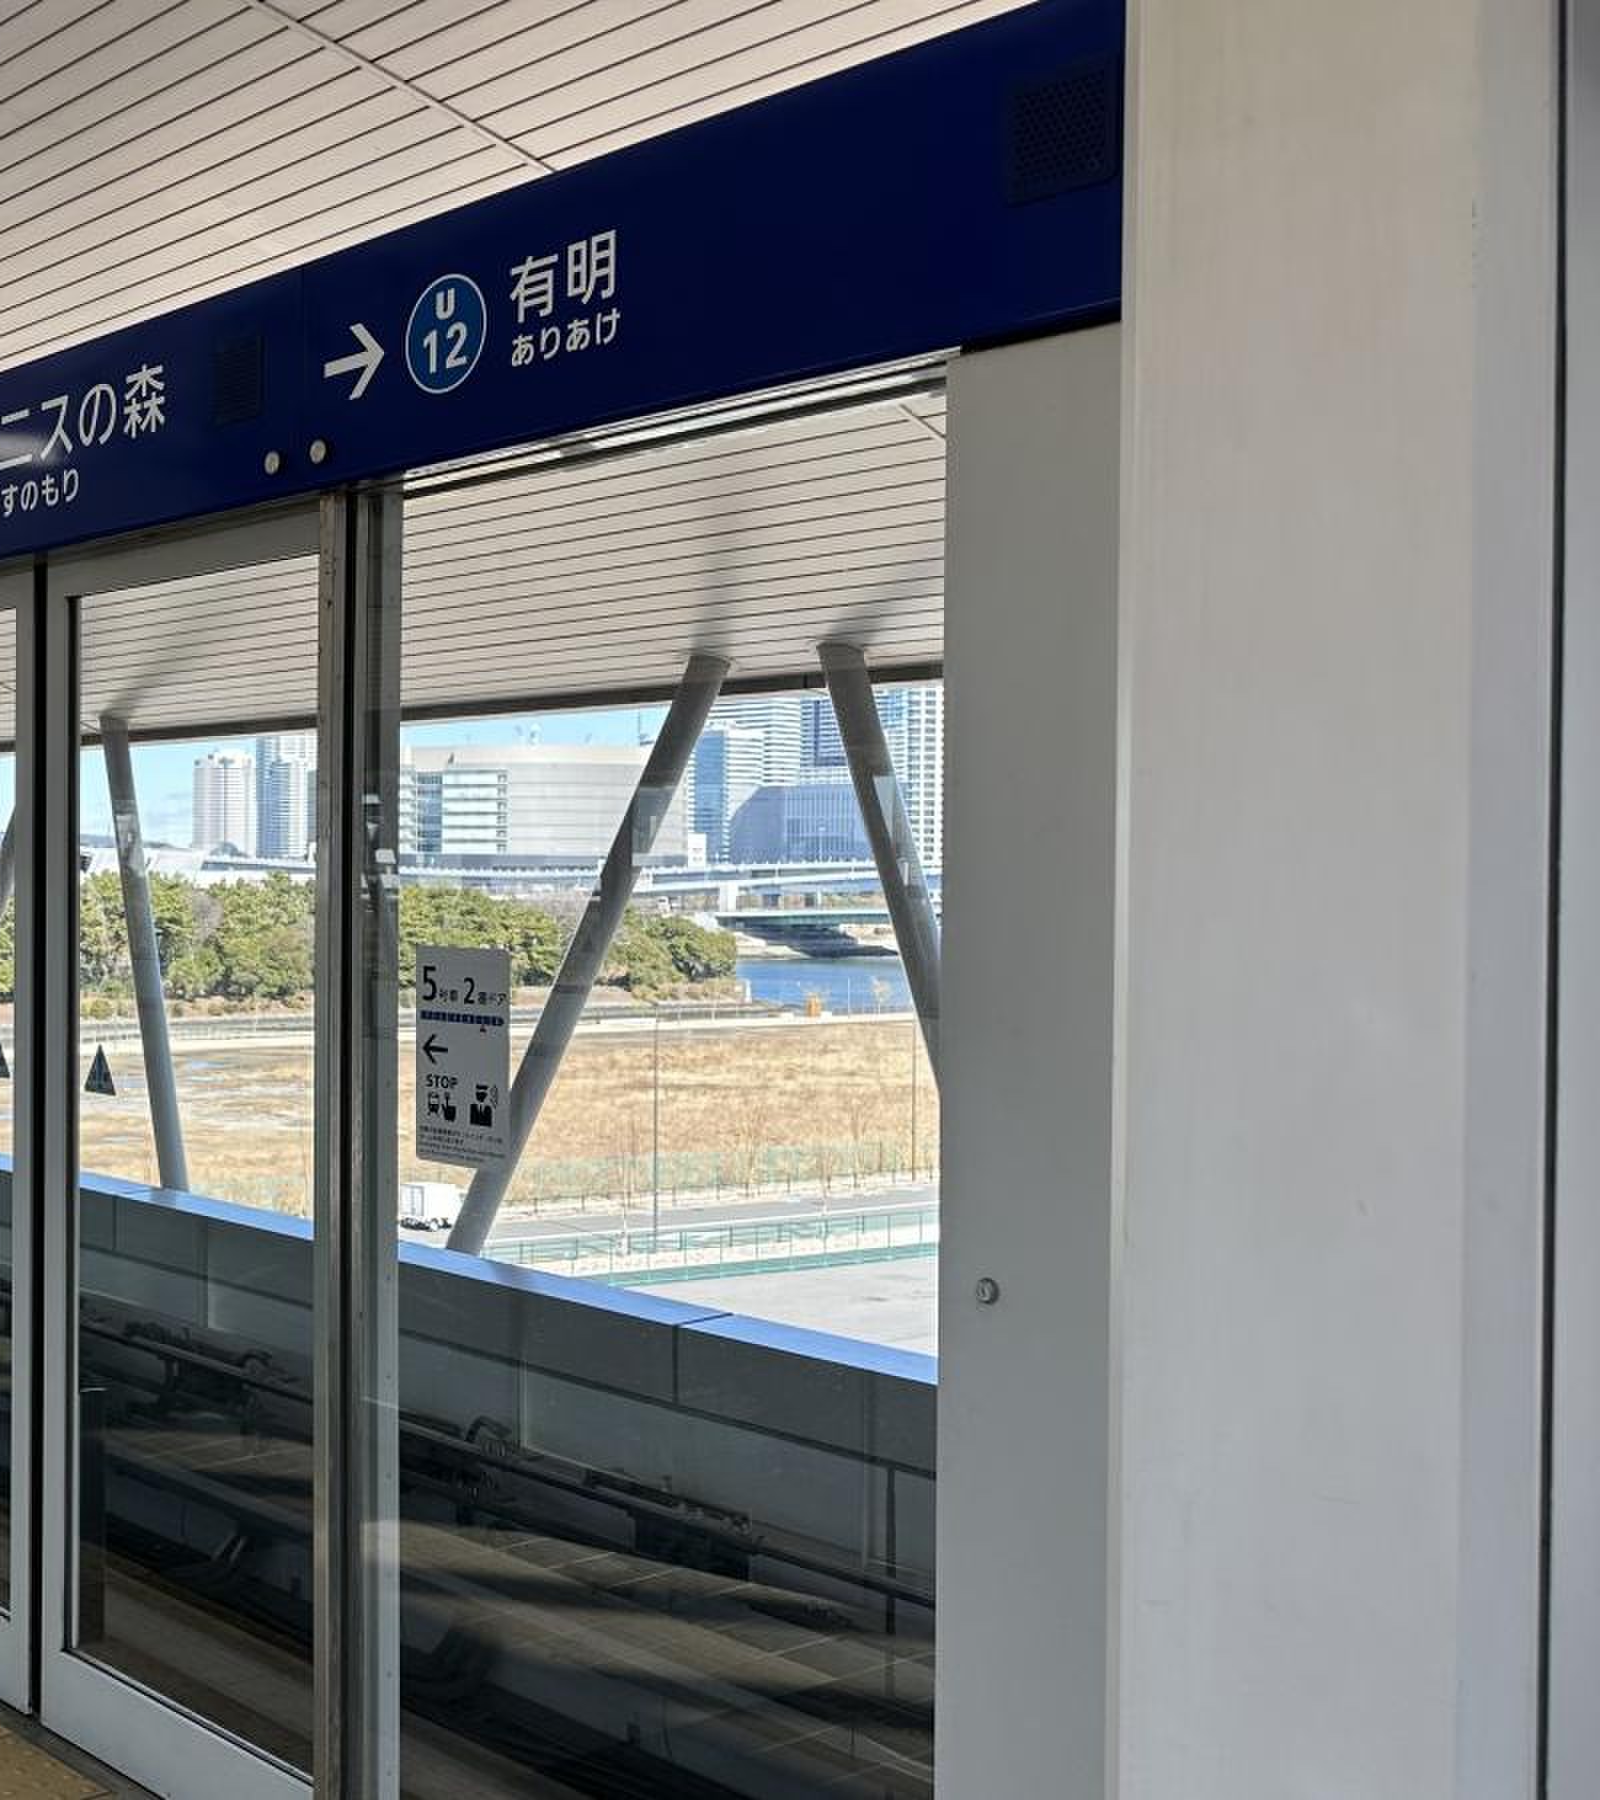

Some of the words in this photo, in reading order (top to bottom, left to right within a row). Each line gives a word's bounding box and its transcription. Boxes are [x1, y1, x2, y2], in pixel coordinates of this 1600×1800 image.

[509, 229, 618, 323] 有明
[436, 288, 455, 320] U
[423, 322, 467, 373] 12
[511, 308, 621, 367] ありあけ
[426, 1074, 458, 1089] STOP
